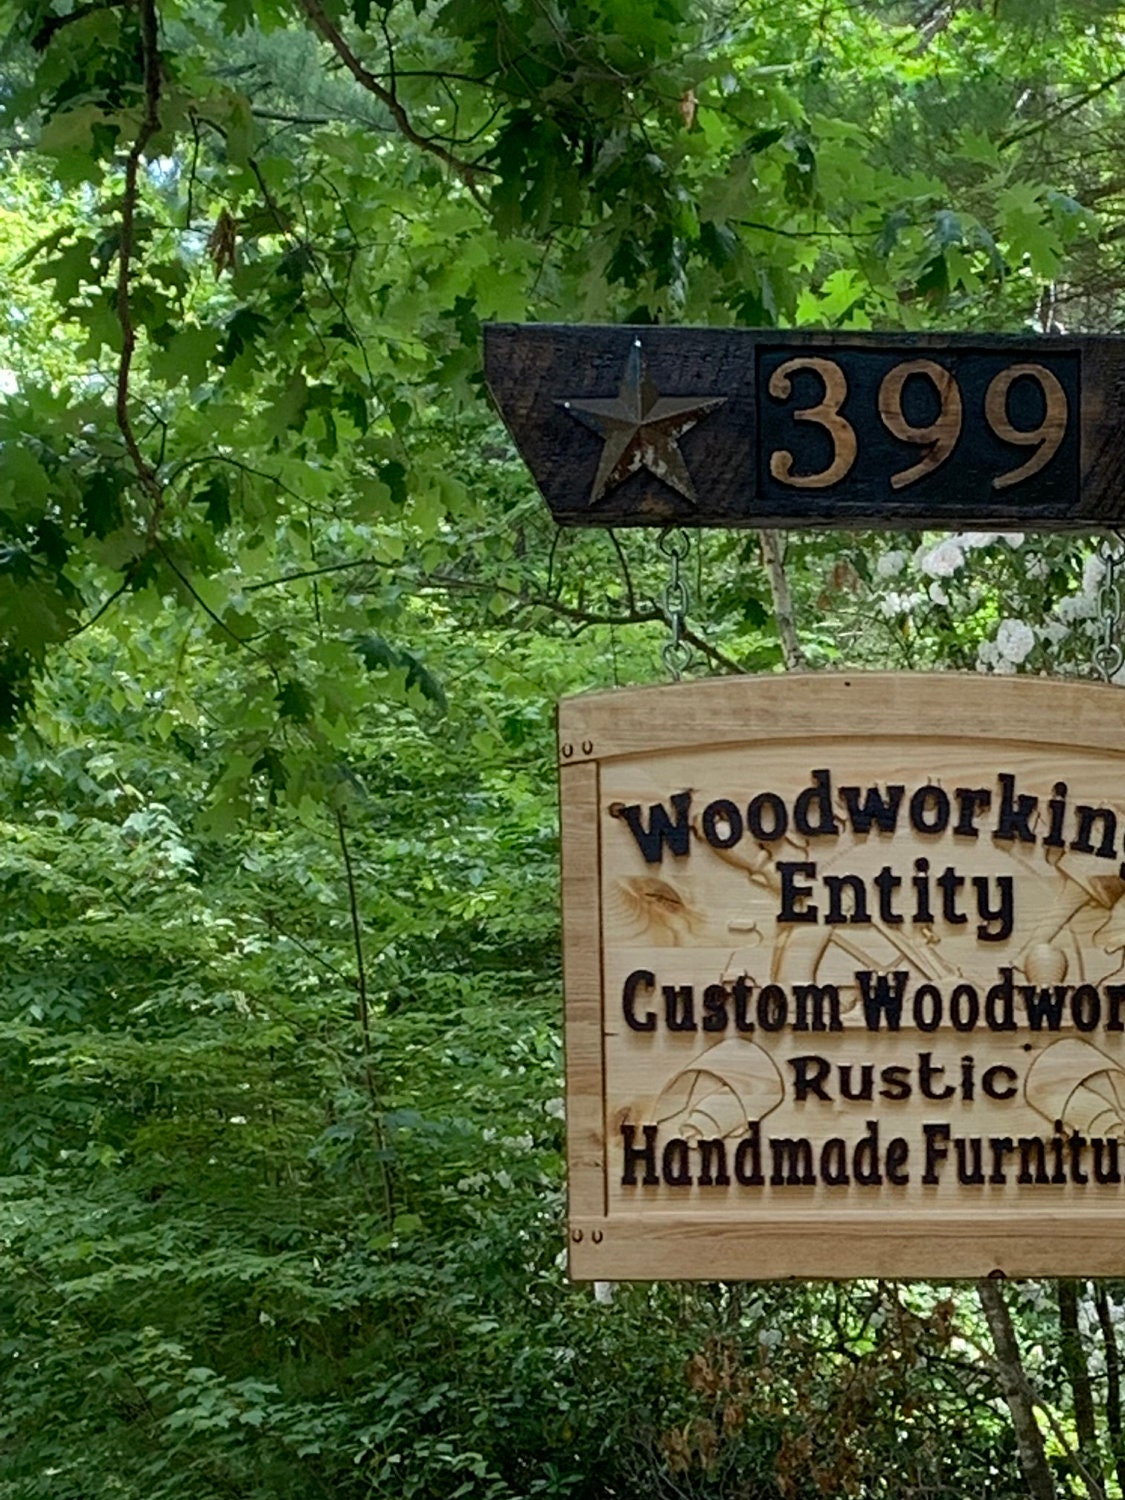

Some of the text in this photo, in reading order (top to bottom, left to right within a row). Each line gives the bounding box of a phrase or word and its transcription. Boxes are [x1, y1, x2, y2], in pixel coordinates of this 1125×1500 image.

[769, 356, 1068, 490] 399
[776, 857, 1014, 942] Entity
[622, 969, 844, 1033] Custom
[787, 1052, 1019, 1102] Rustic
[620, 1120, 910, 1187] Handmade
